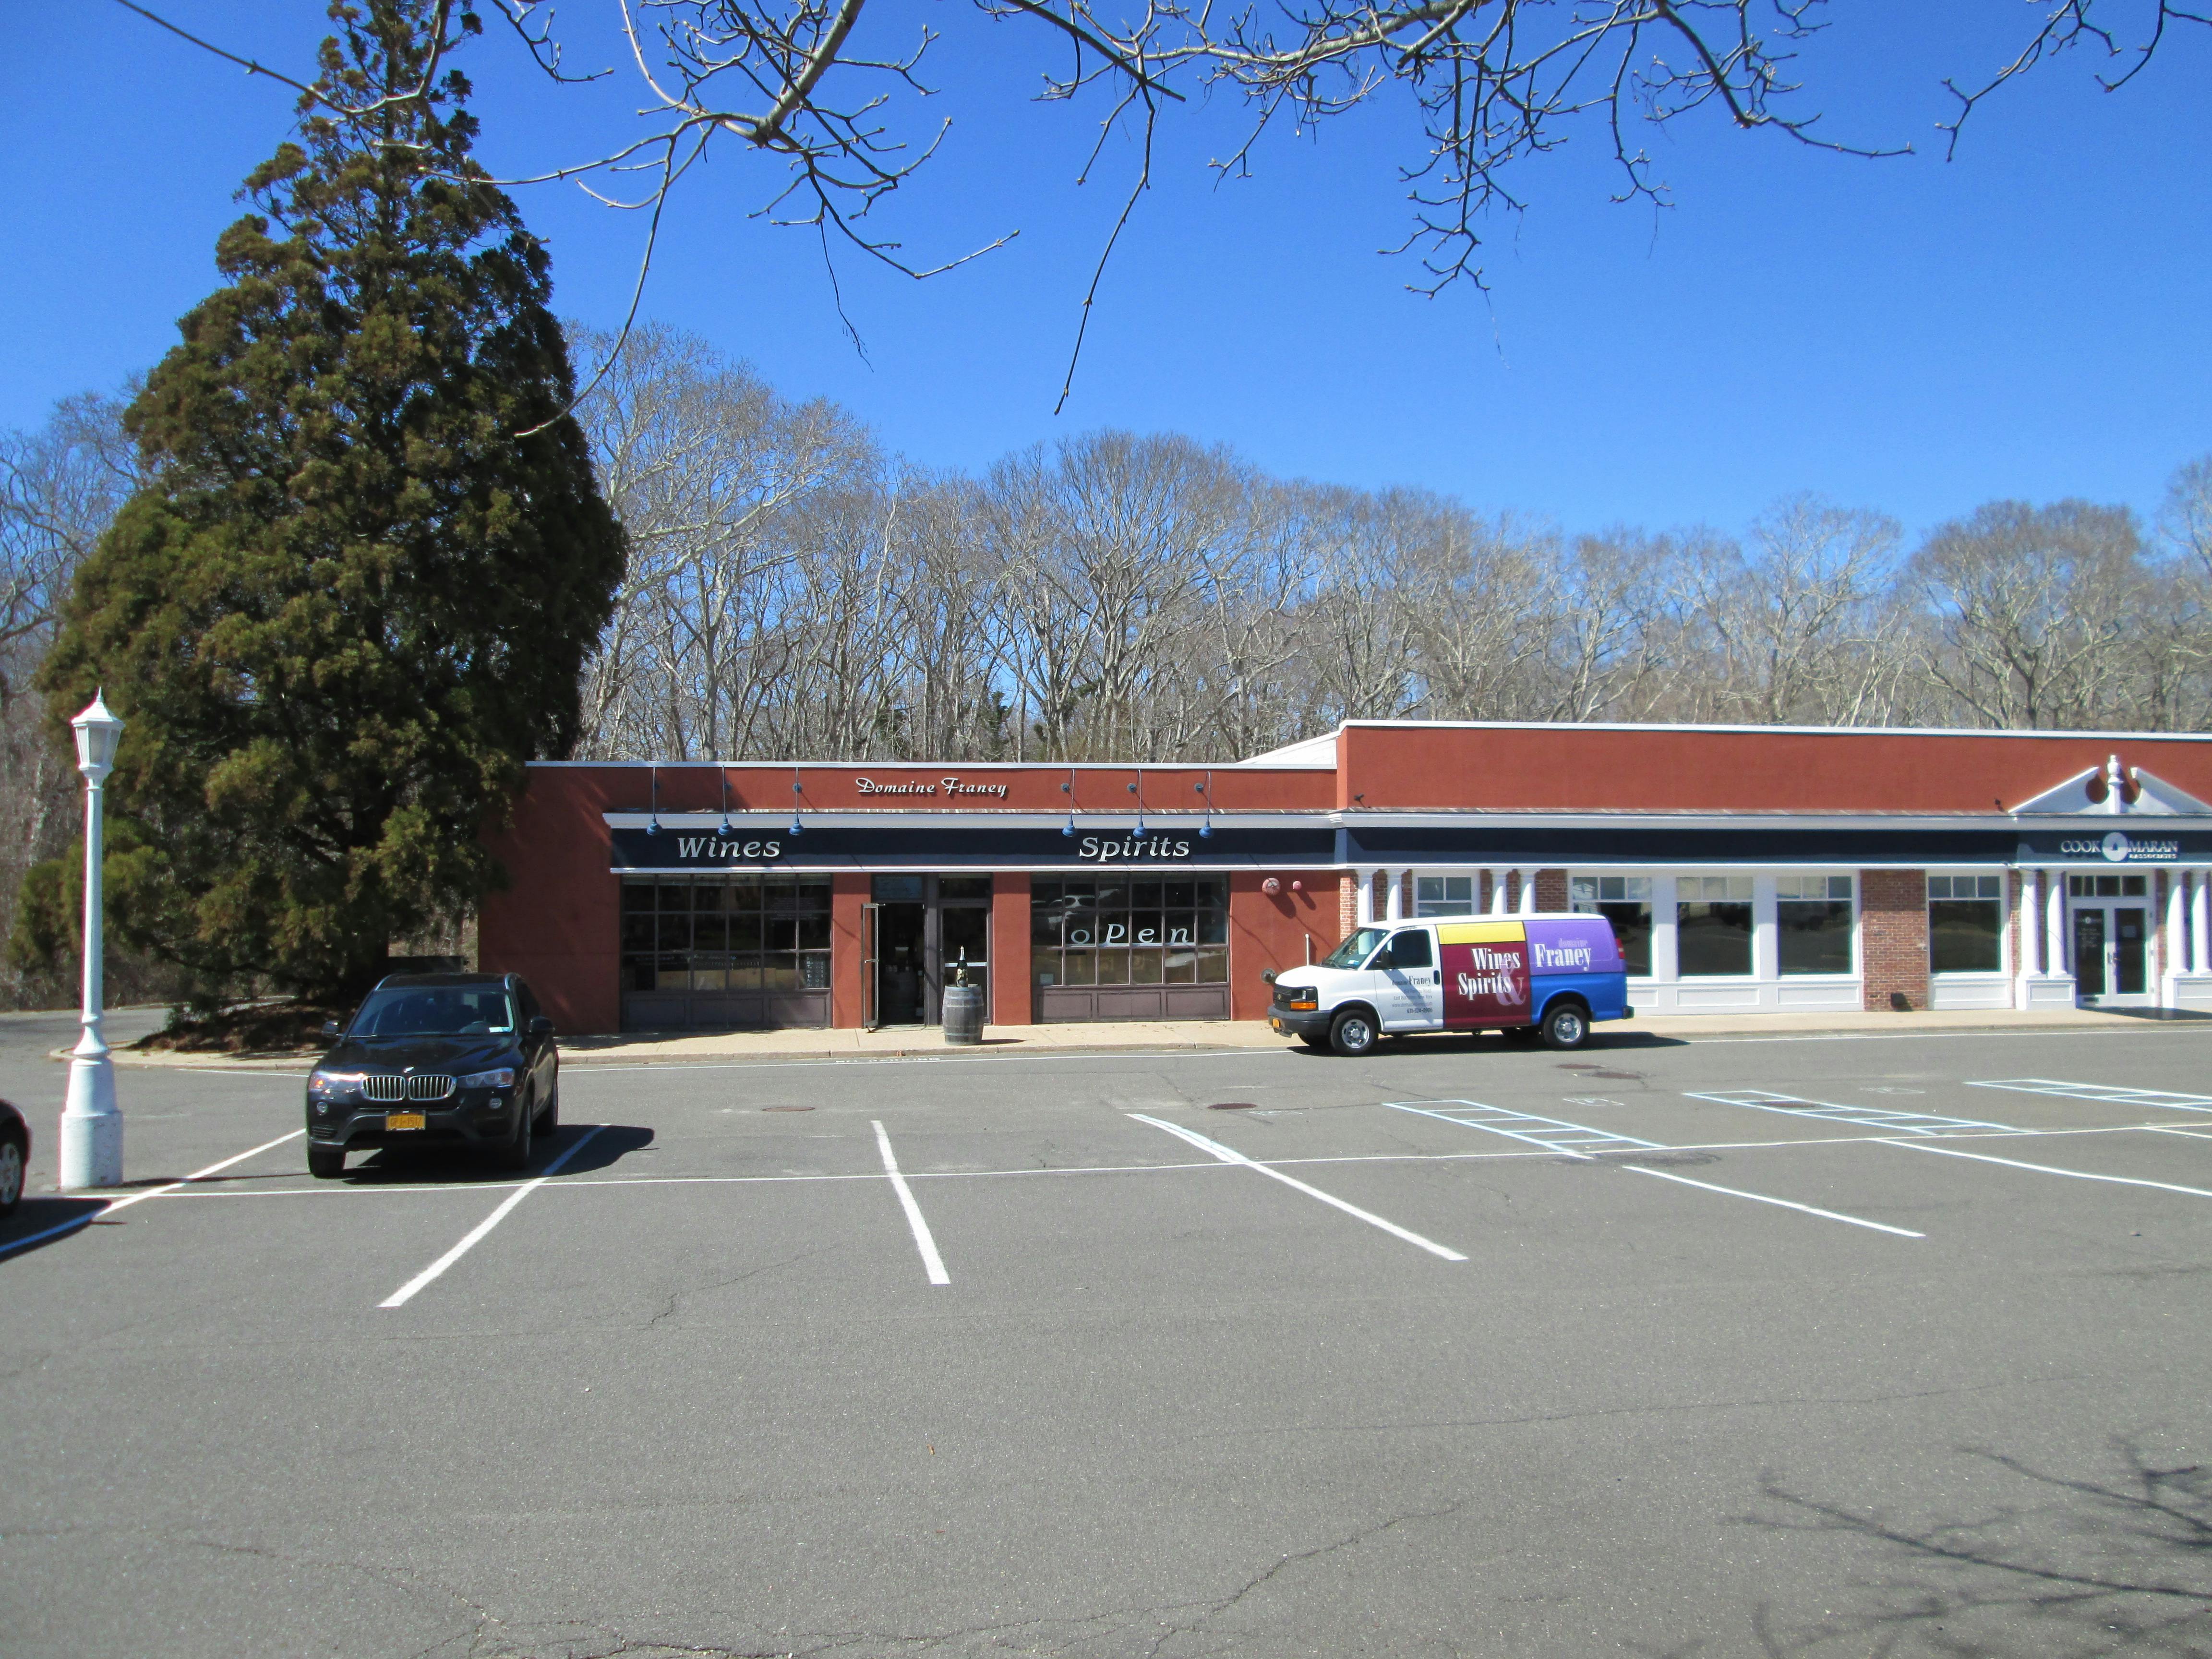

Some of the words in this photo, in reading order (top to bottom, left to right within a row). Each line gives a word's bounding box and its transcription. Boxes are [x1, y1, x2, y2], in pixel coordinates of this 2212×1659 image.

[856, 777, 936, 793] Domaine
[941, 777, 1007, 797] Franey
[677, 837, 781, 858] Wines
[1079, 836, 1190, 862] Spirits
[2061, 841, 2102, 853] COOK
[2128, 841, 2178, 853] MARAN
[1471, 948, 1521, 970] Wines
[1534, 943, 1591, 972] Franey
[1408, 975, 1431, 986] Franey
[1458, 972, 1512, 1001] Spirits
